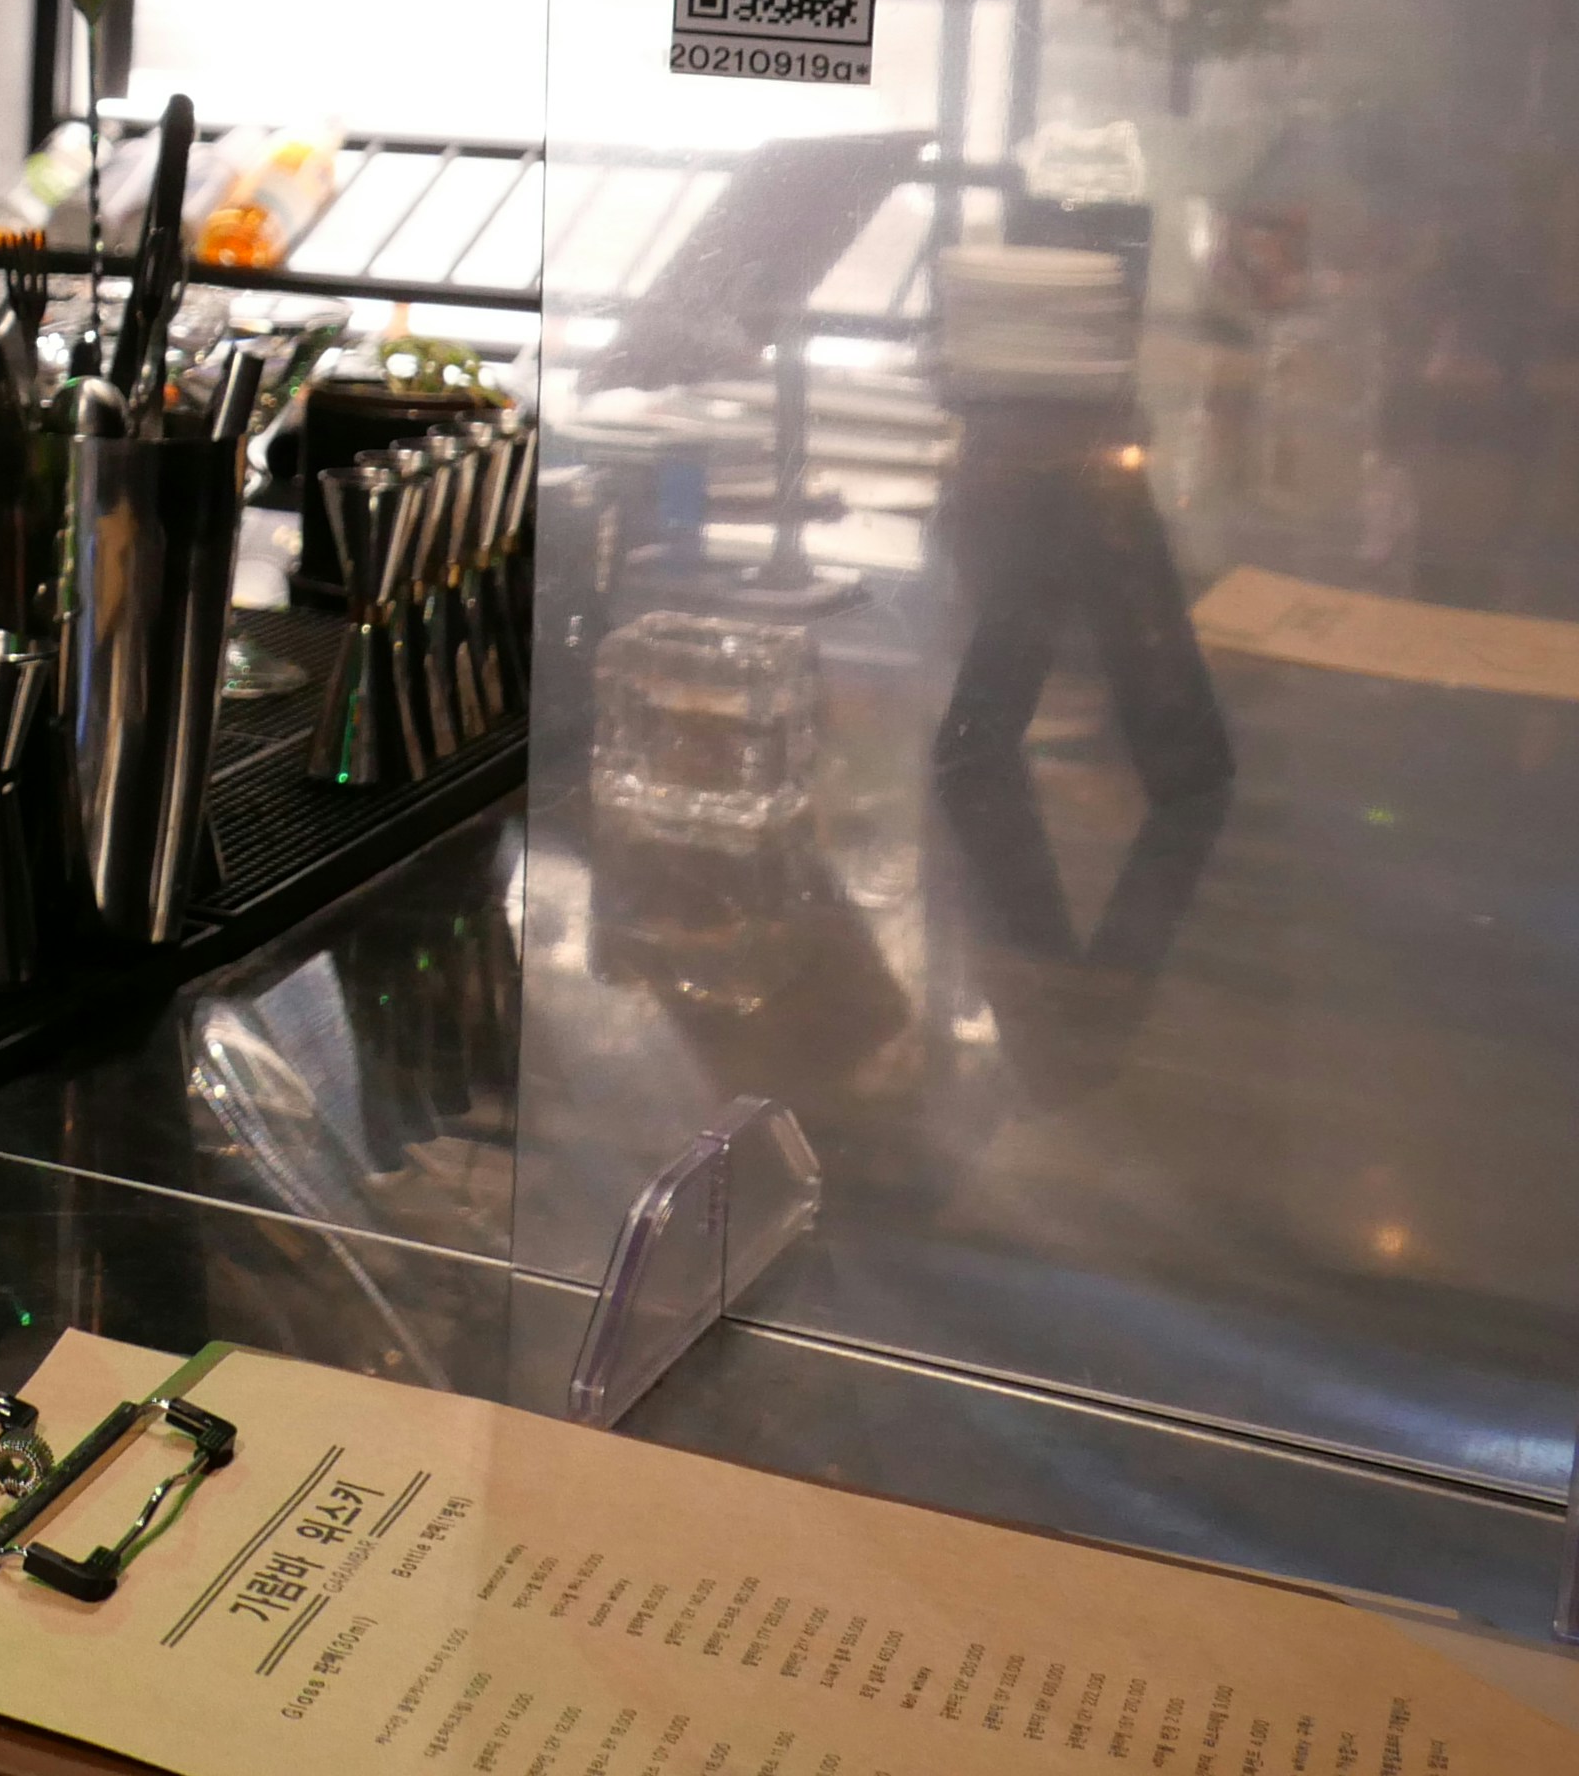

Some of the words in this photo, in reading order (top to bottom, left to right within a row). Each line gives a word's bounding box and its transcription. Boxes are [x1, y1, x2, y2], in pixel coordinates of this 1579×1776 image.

[227, 1550, 326, 1623] 가람바
[295, 1478, 386, 1545] 위스키
[322, 1539, 379, 1594] GARAMBAR
[390, 1543, 432, 1579] Bottle
[280, 1678, 331, 1720] Glass
[312, 1615, 379, 1676] 판매(30ml)
